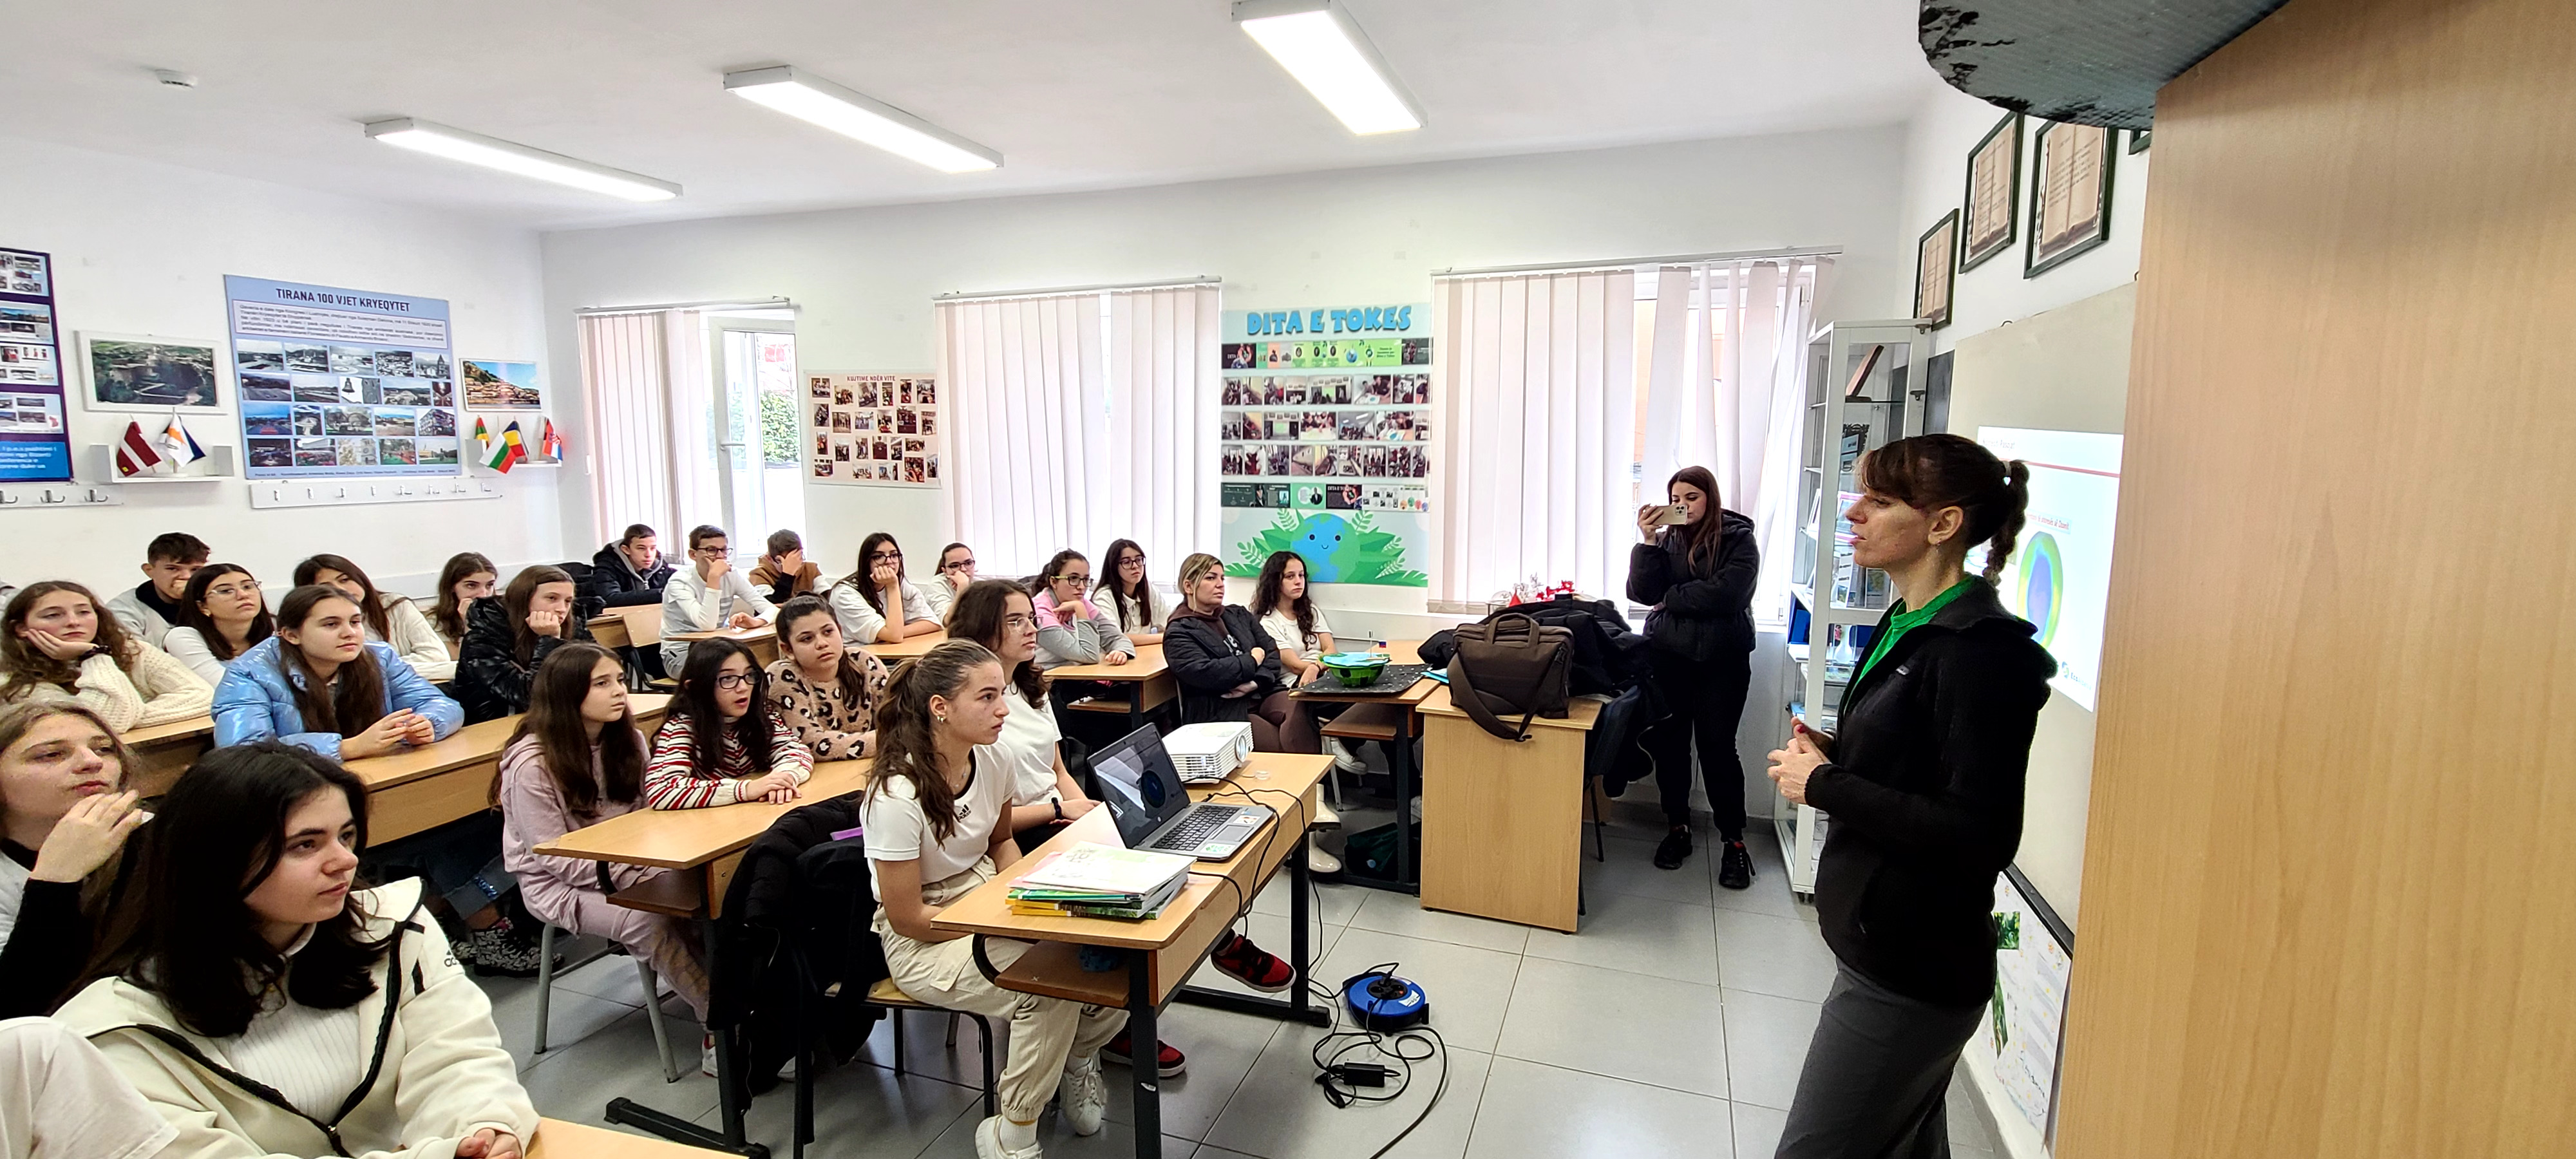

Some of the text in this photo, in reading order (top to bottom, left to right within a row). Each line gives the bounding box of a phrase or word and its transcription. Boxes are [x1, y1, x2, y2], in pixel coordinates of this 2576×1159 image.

[276, 288, 410, 312] TIRANA 100 VJET KRYEQYTET
[1247, 305, 1412, 335] DITA E TOKES
